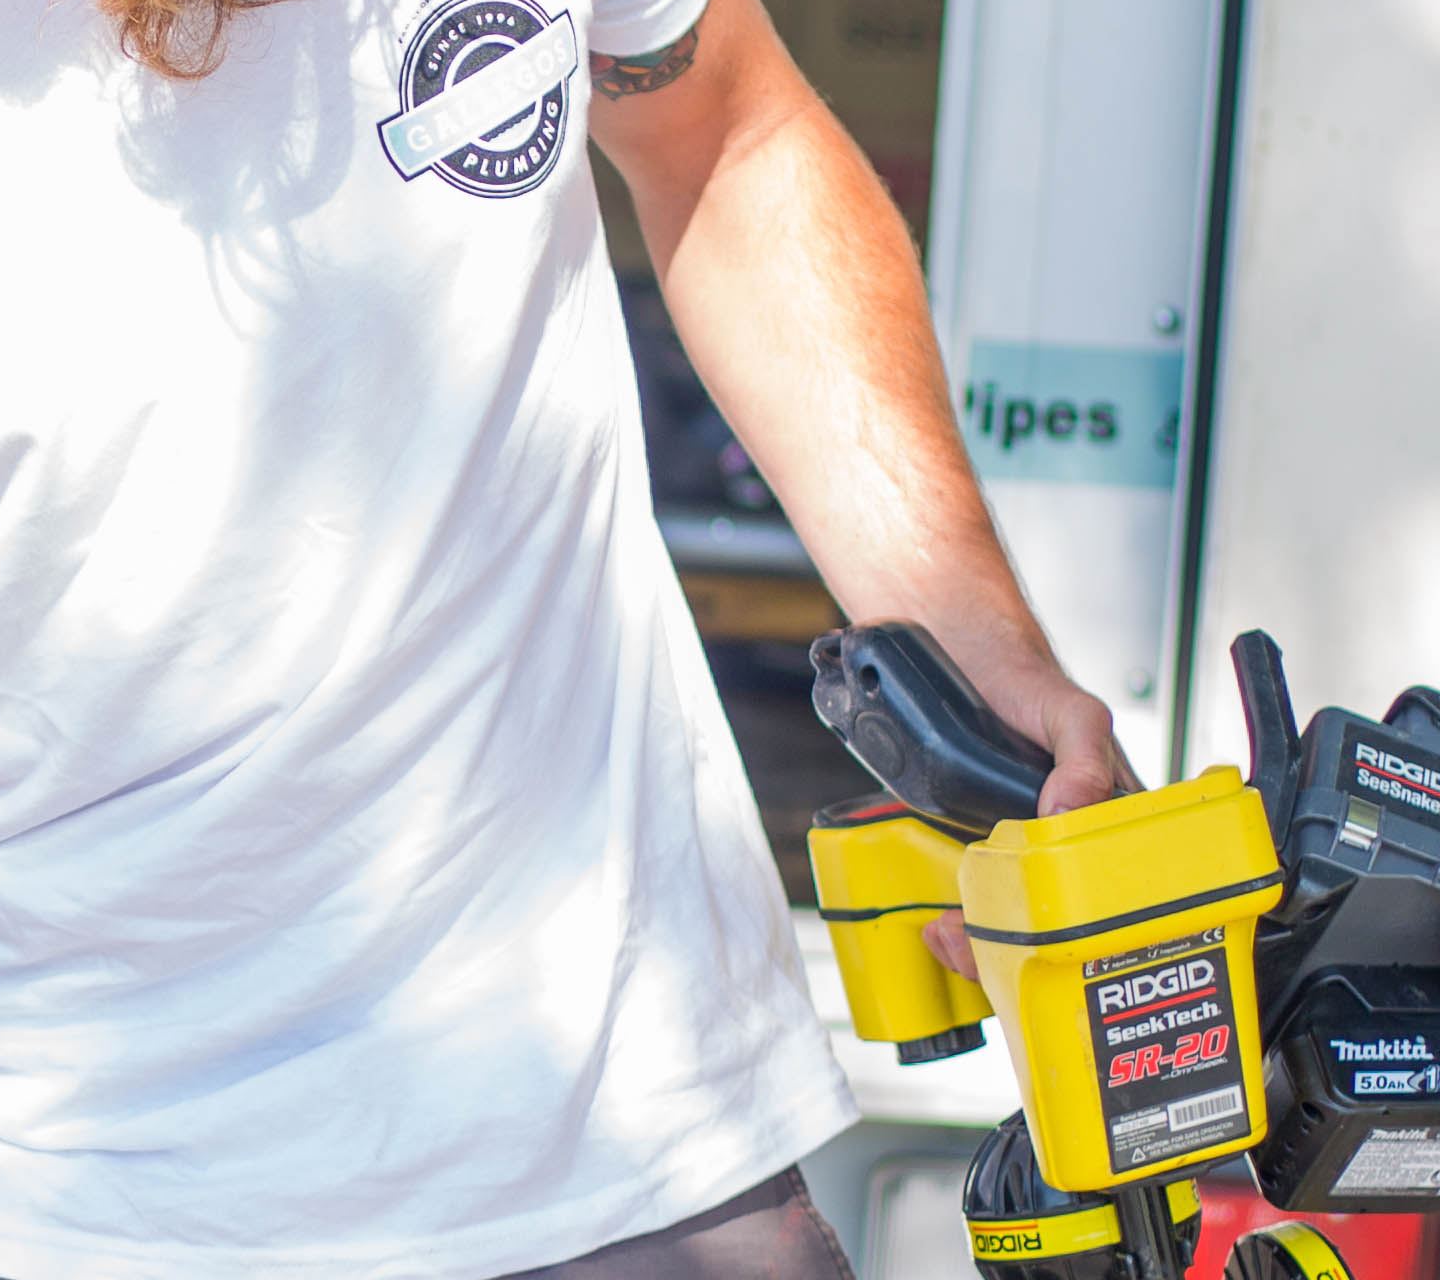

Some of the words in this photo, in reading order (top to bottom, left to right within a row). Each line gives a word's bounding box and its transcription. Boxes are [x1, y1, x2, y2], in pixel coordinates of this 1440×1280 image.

[427, 21, 466, 71] SINCE
[462, 100, 560, 178] PLUMBING
[1096, 958, 1215, 1015] RIDGID
[1106, 1000, 1220, 1047] SeekTech
[1107, 1023, 1231, 1088] SR-20
[1360, 1075, 1405, 1090] 5.0Ah
[975, 1232, 1043, 1253] RIDGID
